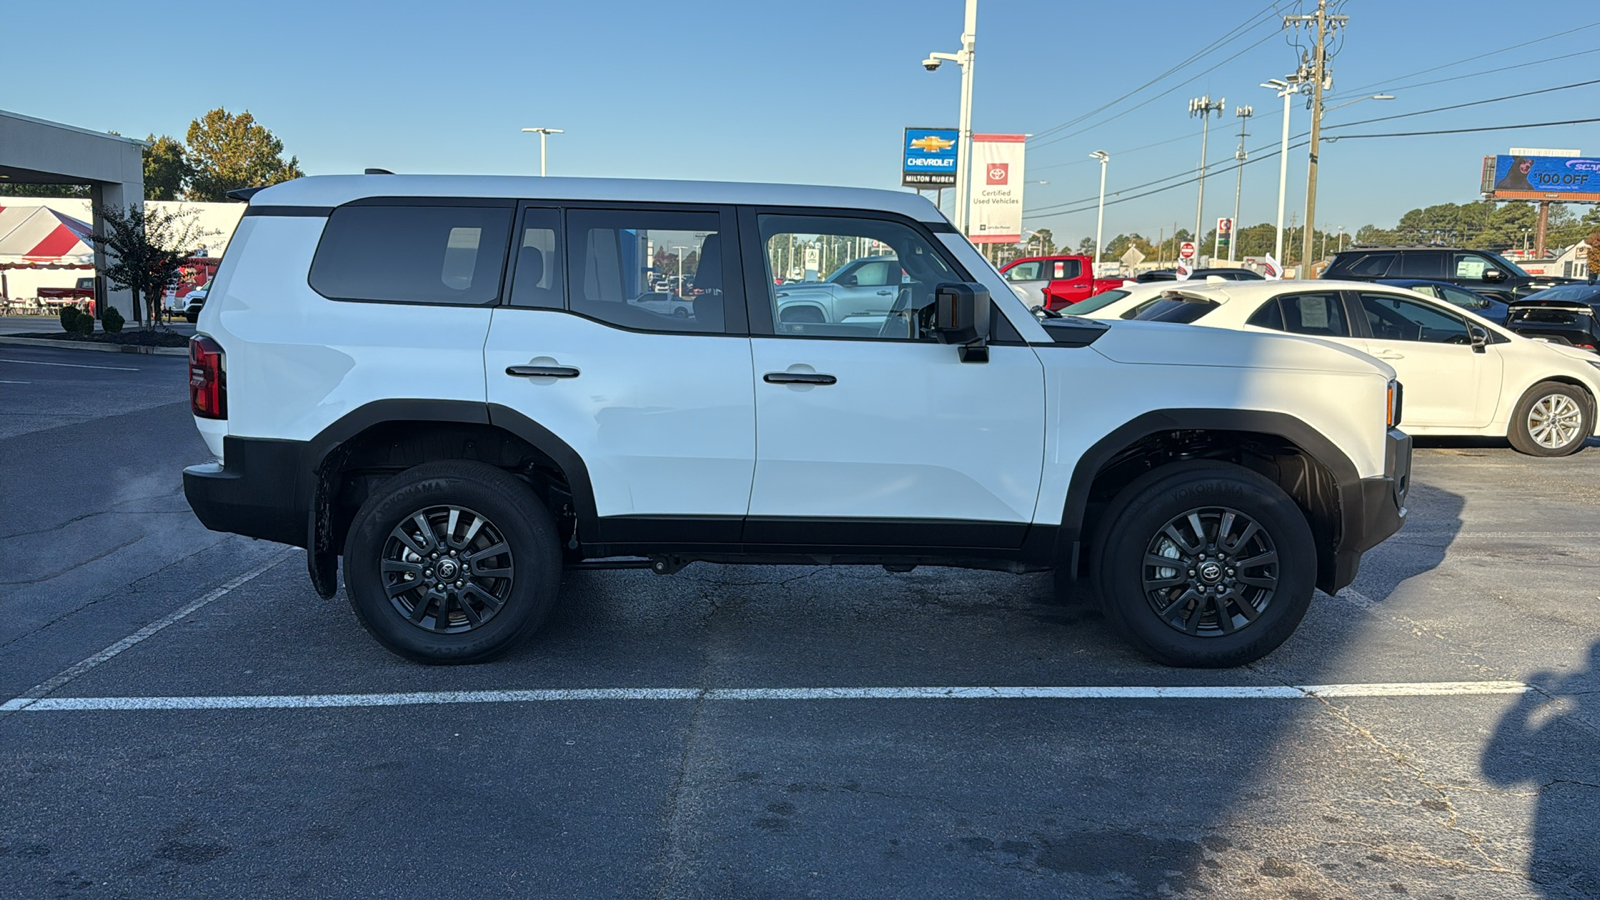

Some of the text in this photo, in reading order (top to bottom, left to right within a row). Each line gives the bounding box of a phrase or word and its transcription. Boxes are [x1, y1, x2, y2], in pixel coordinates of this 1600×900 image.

[907, 158, 954, 167] CHEVROLET
[905, 175, 955, 183] MILTON RUBEN
[1534, 173, 1589, 185] $100 OFF
[981, 189, 1011, 197] Certified
[973, 197, 1019, 205] Used Vehicles
[376, 481, 442, 517] YOKOHAMA
